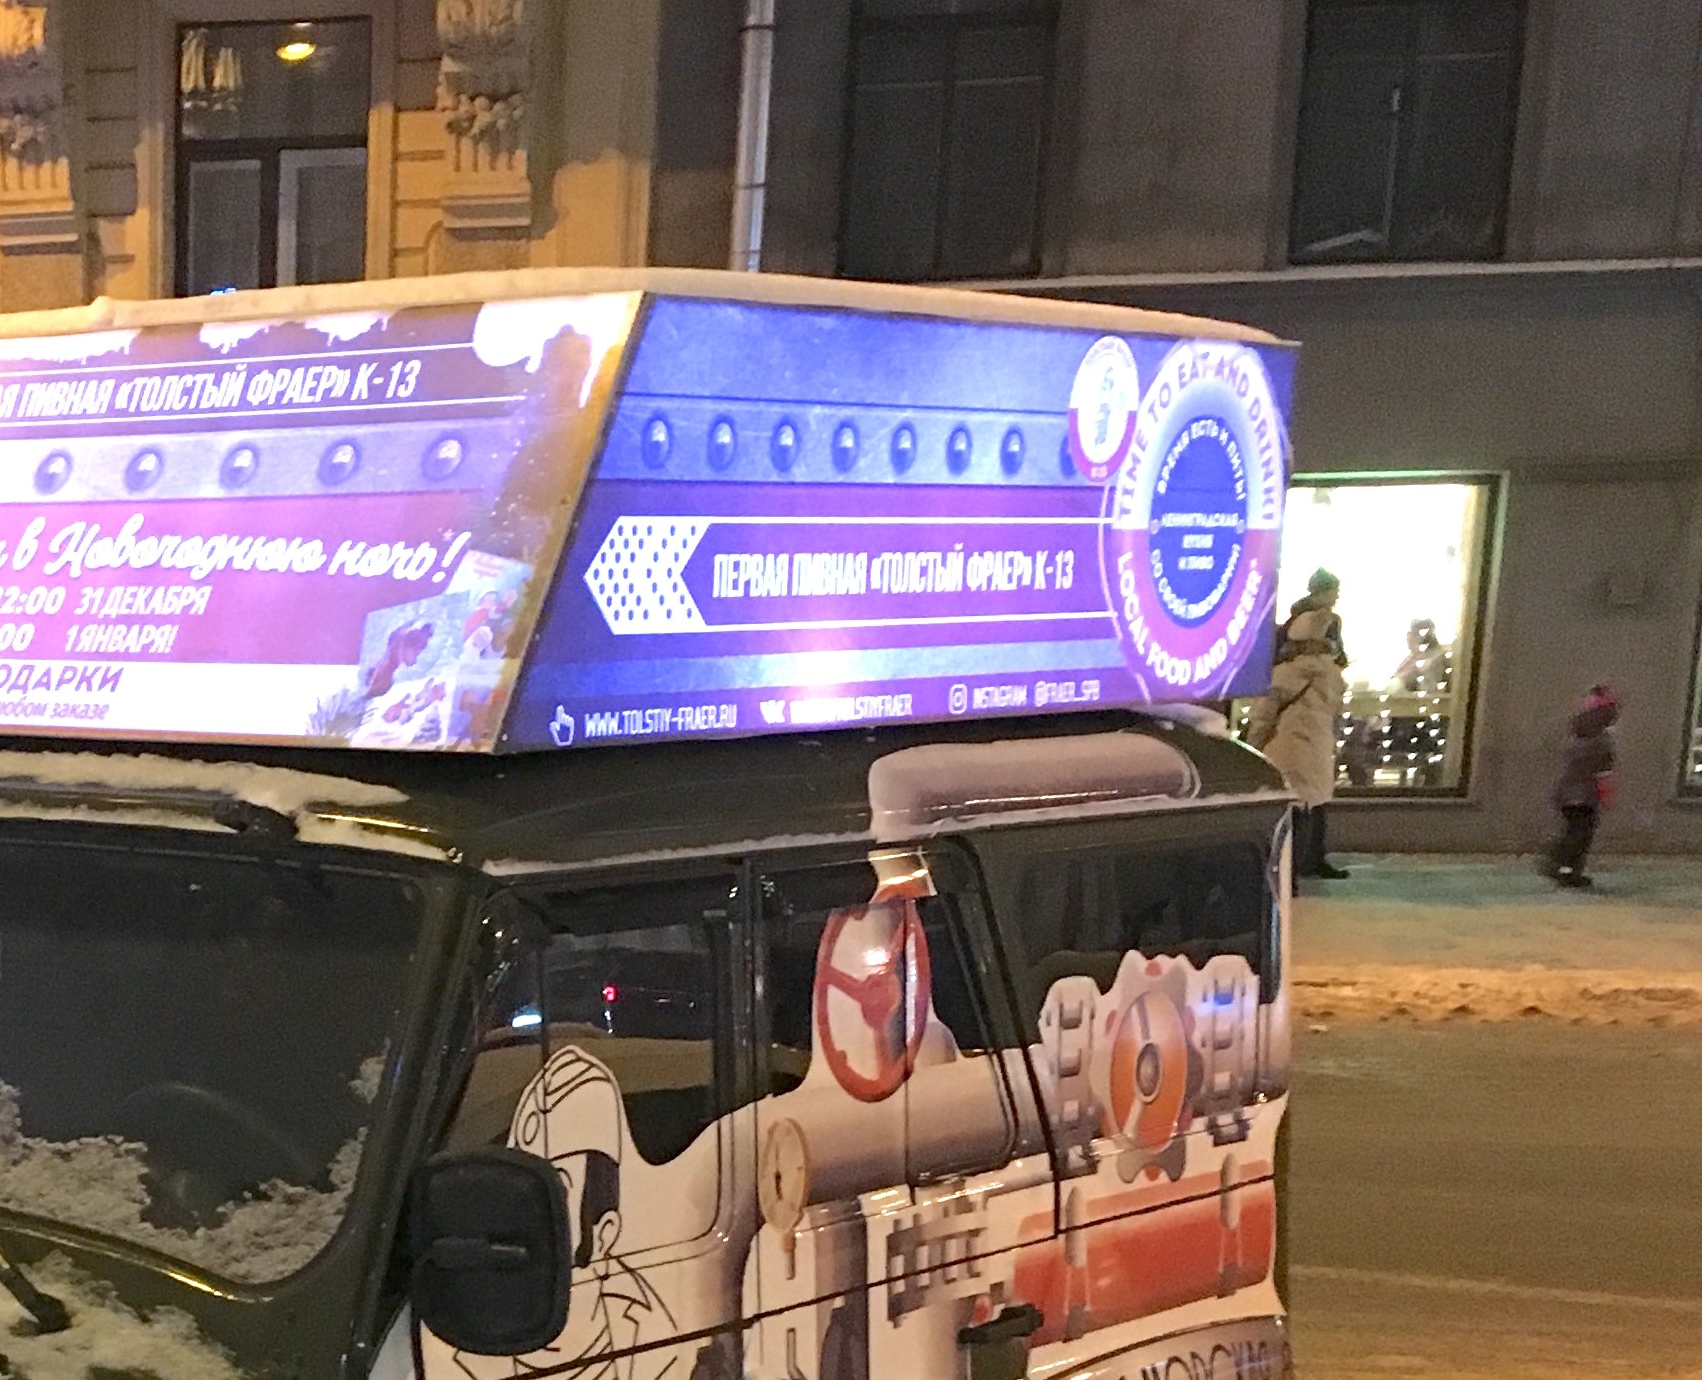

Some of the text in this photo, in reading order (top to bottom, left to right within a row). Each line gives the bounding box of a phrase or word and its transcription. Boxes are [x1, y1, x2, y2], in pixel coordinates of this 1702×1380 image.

[17, 379, 115, 418] ПИВНАЯ
[115, 361, 246, 412] «ТОЛСТЫЙ
[246, 364, 348, 405] ФРАЕР»
[1148, 382, 1171, 423] TO
[12, 516, 46, 571] в
[44, 512, 327, 580] Новогоднюю
[328, 531, 471, 582] ночь!
[713, 553, 789, 597] ПЕРВАЯ
[792, 553, 867, 596] ПИВНАЯ
[870, 543, 964, 594] «ТОЛСТЫЙ
[1146, 642, 1191, 686] FOOD
[1193, 638, 1227, 683] AND
[49, 703, 110, 720] заказе
